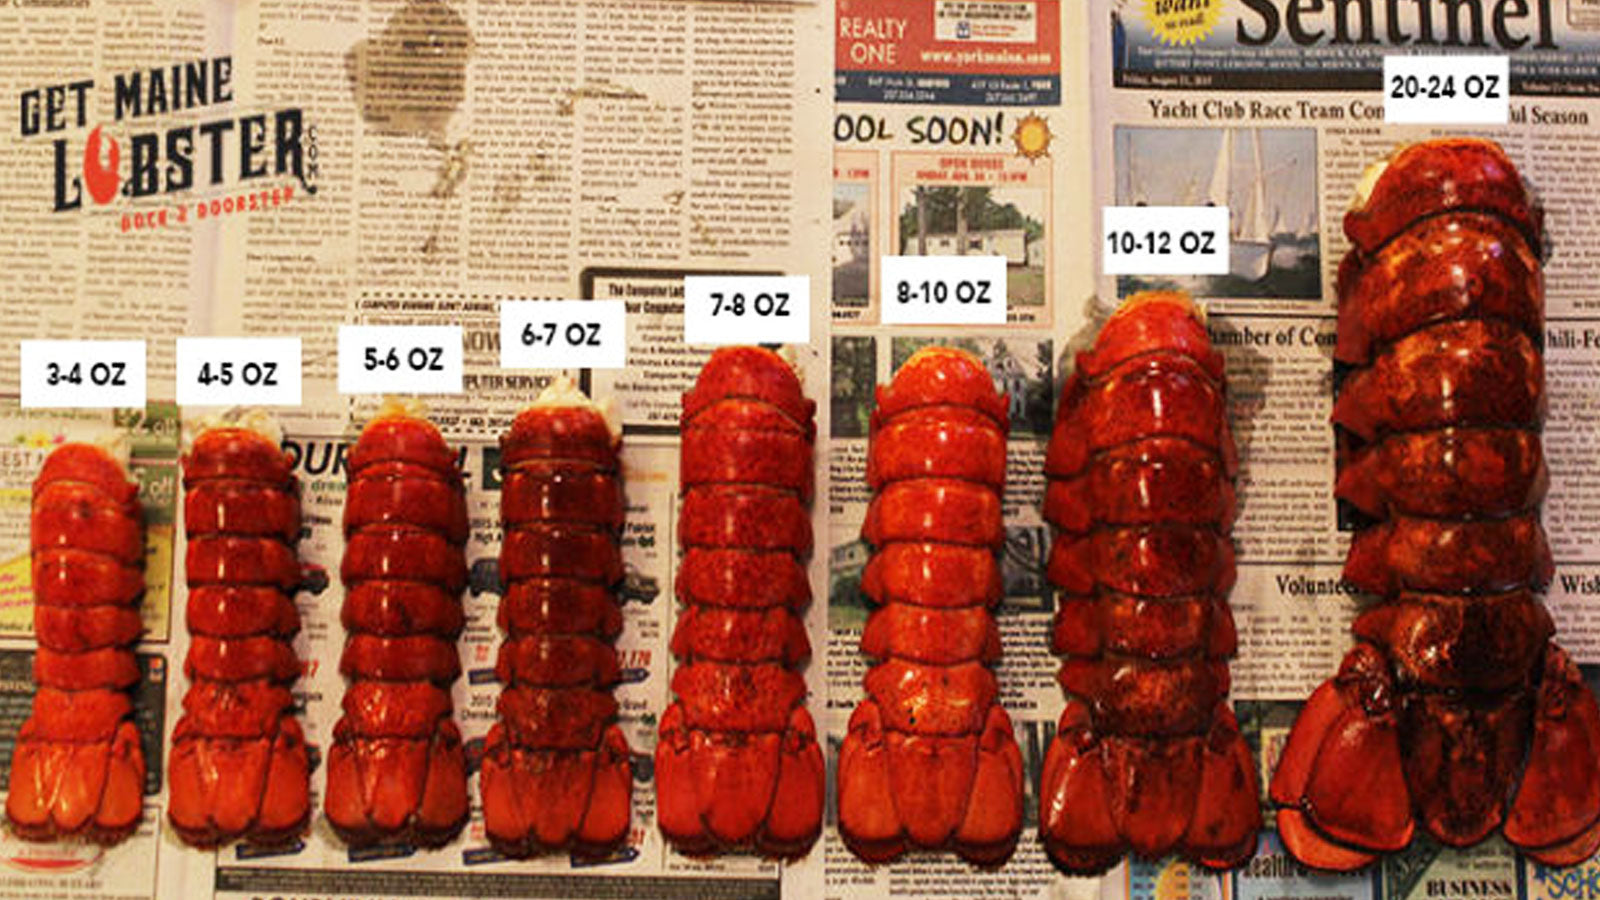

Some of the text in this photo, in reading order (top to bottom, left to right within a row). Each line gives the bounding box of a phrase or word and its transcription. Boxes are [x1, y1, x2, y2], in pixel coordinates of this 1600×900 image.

[839, 17, 907, 39] REALTY
[1235, 0, 1559, 49] Sentinel
[850, 42, 898, 64] ONE
[1149, 100, 1197, 120] Yacht
[1202, 100, 1246, 120] Club
[1251, 100, 1293, 120] Race
[1297, 100, 1344, 120] Team
[1531, 105, 1589, 126] Season
[906, 111, 1005, 146] SOON!
[1275, 325, 1296, 346] of
[1426, 880, 1513, 896] BUSINESS
